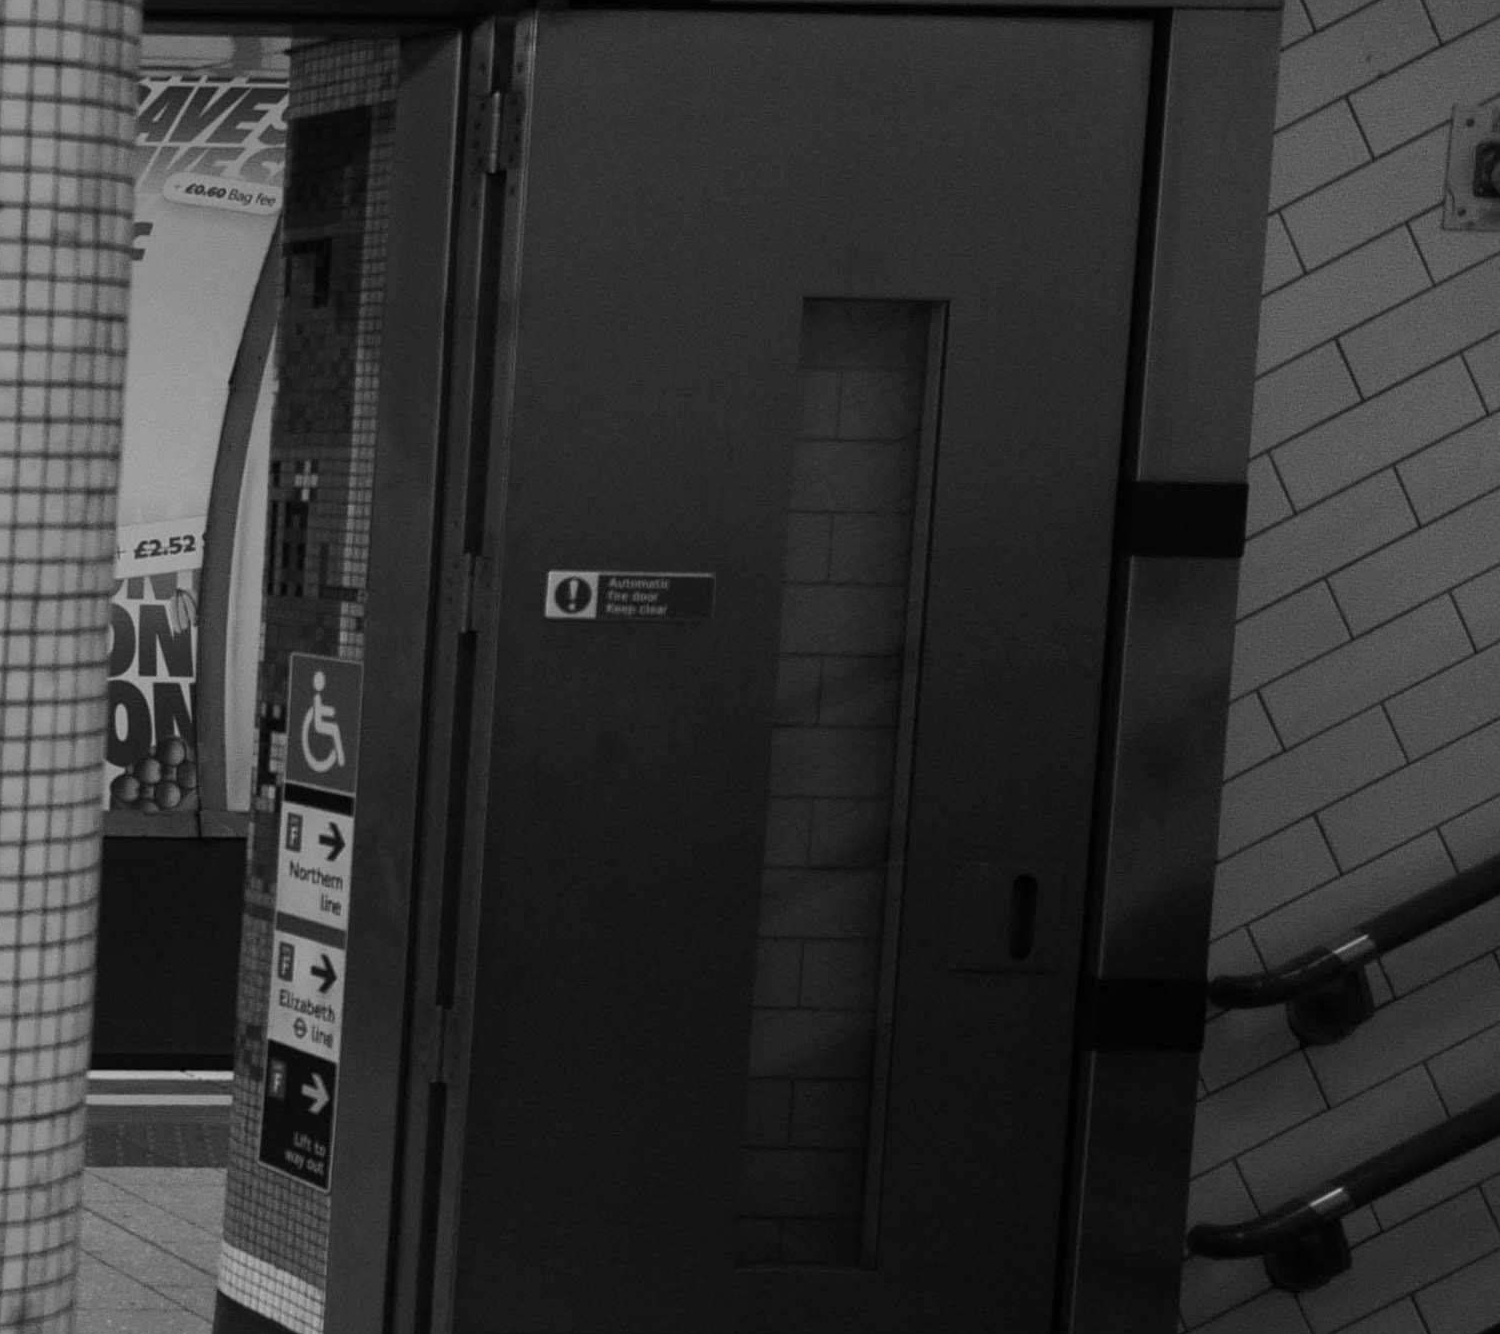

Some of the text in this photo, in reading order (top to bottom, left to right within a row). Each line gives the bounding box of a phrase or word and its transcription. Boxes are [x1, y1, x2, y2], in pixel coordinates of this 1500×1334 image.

[184, 182, 227, 199] £0.60
[228, 187, 253, 206] Bag
[255, 191, 277, 208] fee
[133, 534, 196, 561] £2.52
[289, 860, 343, 891] Northern
[320, 893, 341, 916] line
[279, 988, 336, 1024] Elizabeth
[311, 1025, 334, 1049] line
